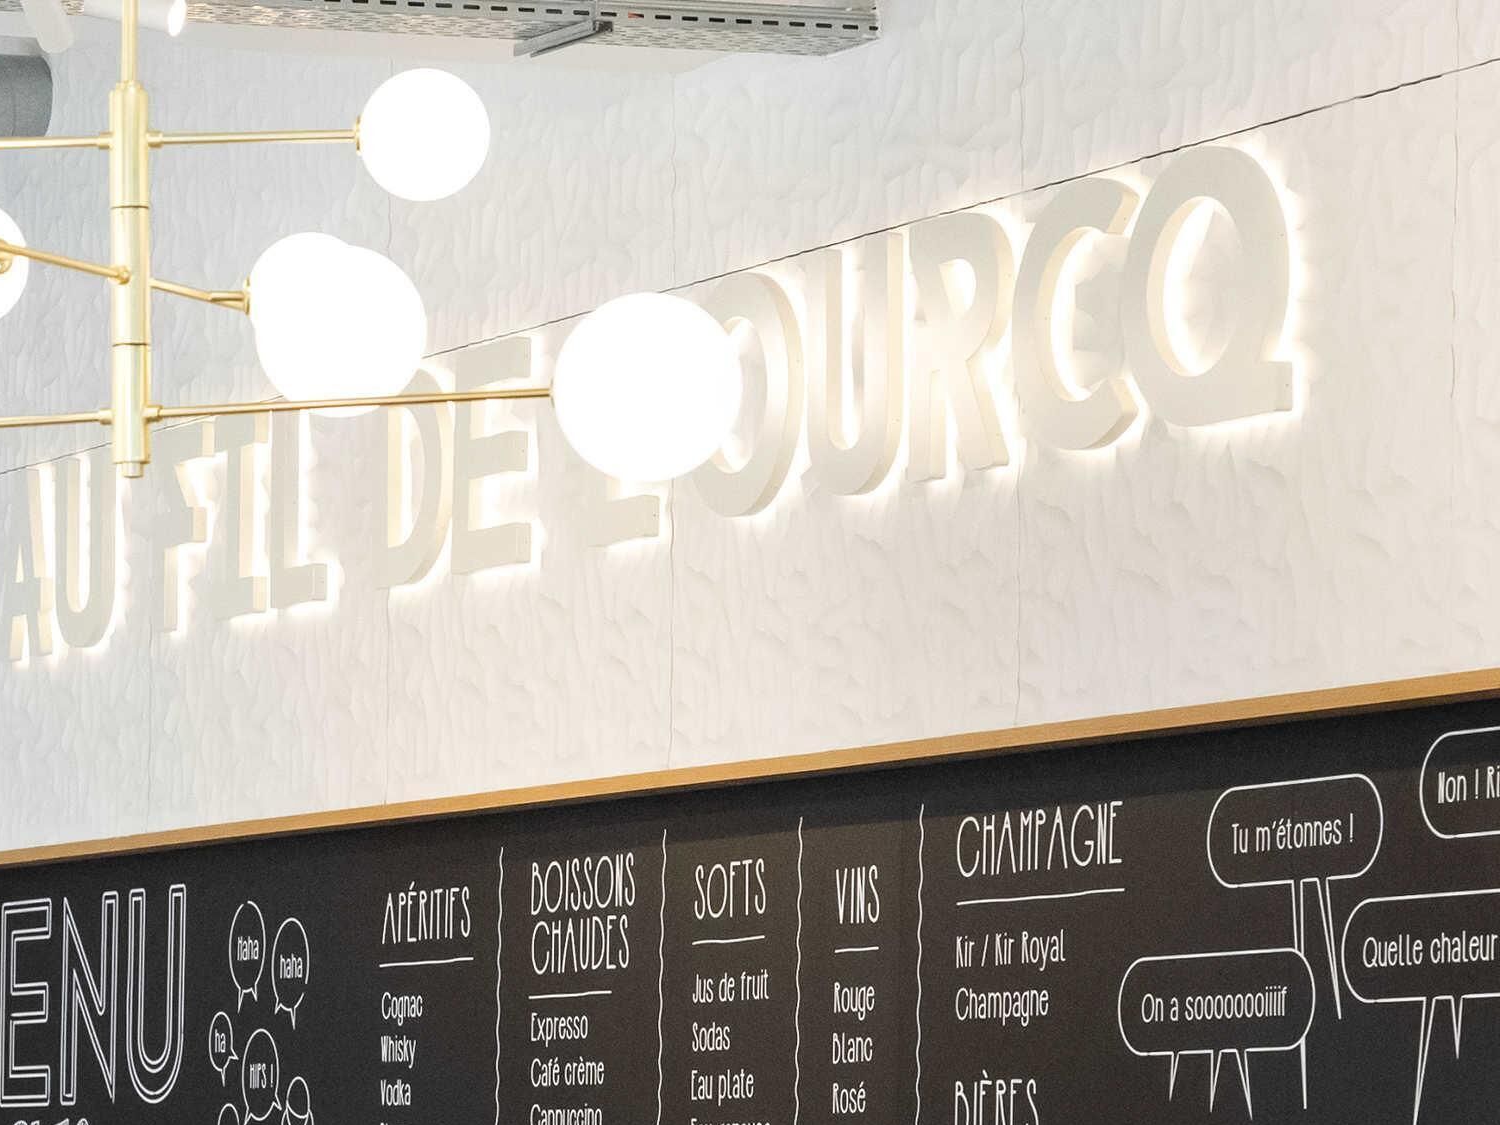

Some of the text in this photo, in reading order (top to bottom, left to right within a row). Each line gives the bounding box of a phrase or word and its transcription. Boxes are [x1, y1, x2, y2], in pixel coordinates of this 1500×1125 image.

[0, 453, 122, 662] AU
[148, 398, 328, 632] FIL
[375, 335, 533, 590] DE
[1437, 771, 1467, 804] Non
[956, 800, 1124, 878] CHAMPAGNE
[1231, 822, 1249, 855] Tu
[1255, 817, 1342, 853] m'étonnes
[531, 851, 636, 915] BOISSONS
[694, 857, 767, 921] SOFTS
[835, 864, 880, 925] VINS
[381, 880, 471, 945] APÉRITIFS
[236, 935, 260, 961] Haha
[531, 914, 630, 975] CHAUDES
[955, 928, 1067, 972] Kir / Kir Royal
[1362, 930, 1499, 969] Quelle chaleur
[279, 953, 303, 979] haha
[692, 968, 770, 1004] Jus de fruit
[833, 981, 875, 1022] Rouge
[381, 991, 423, 1025] Cognac
[955, 986, 1049, 1027] Champagne
[1141, 993, 1164, 1023] On
[1169, 996, 1179, 1022] a
[214, 1028, 227, 1053] ha
[530, 1012, 589, 1048] Expresso
[691, 1021, 731, 1053] Sodas
[380, 1034, 417, 1069] Whisky
[832, 1032, 873, 1065] Blanc
[530, 1055, 605, 1088] Café crème
[690, 1068, 754, 1107] Eau plate
[380, 1079, 412, 1107] Vodka
[832, 1080, 866, 1114] Rosé
